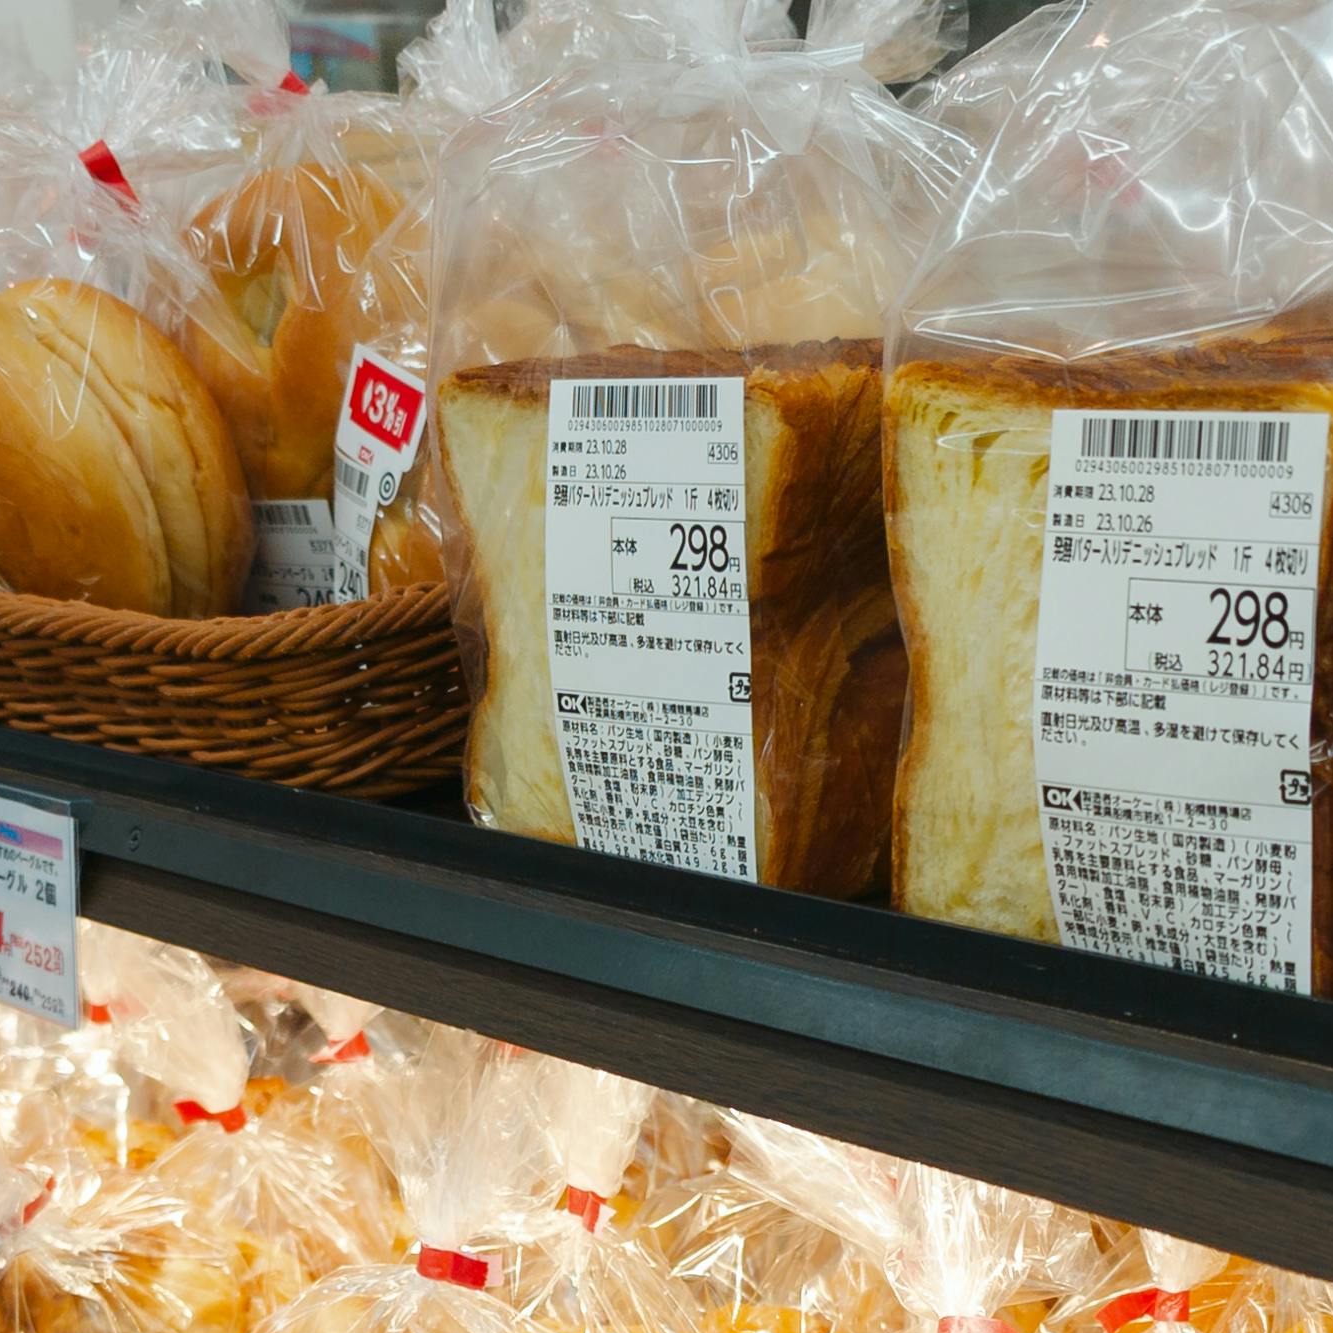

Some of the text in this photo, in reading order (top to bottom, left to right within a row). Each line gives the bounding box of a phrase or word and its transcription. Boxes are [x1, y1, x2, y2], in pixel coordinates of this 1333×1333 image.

[552, 439, 627, 455] 消費期限 23.10.28
[708, 444, 738, 461] 4306
[552, 464, 627, 480] 製造日 23.10.26
[553, 484, 739, 512] 発酵バター入りデニッシュブレッド 1斤 4枚切り
[1053, 484, 1155, 502] 消費期限 23.10.28
[1271, 494, 1313, 515] 4306
[1053, 513, 1153, 533] 製造日 23.10.26
[612, 537, 637, 555] 本体
[1052, 537, 1308, 576] 発酵バター入りデニッシュブレッド 1斤 4枚切り
[553, 607, 645, 626] 原材料等は下部に記載
[1128, 603, 1163, 624] 本体
[560, 695, 582, 712] OK
[1041, 685, 1166, 711] 原材料等は下部に記載
[1047, 789, 1075, 808] OK
[36, 879, 57, 907] 2個
